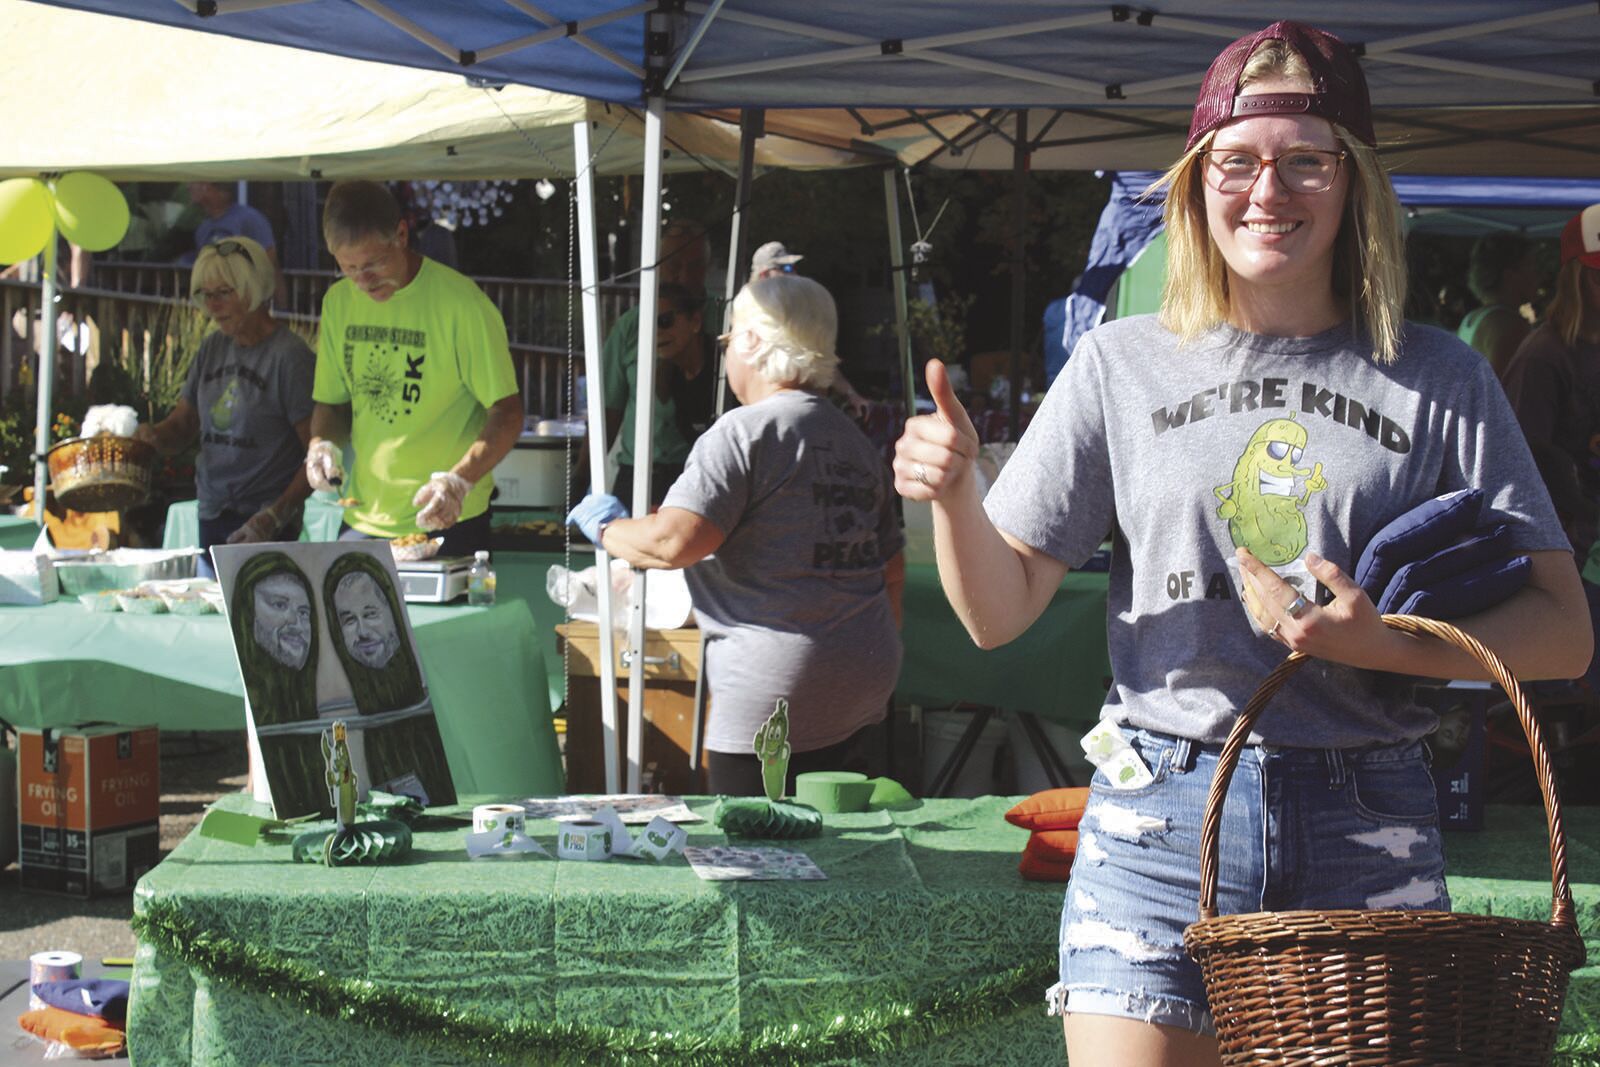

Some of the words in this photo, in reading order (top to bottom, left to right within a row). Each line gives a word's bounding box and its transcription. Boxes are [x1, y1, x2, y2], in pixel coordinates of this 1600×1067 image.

[402, 351, 426, 405] 5K
[1150, 377, 1289, 436] WE'RE
[1300, 381, 1412, 455] KIND
[1166, 570, 1196, 601] OF
[1205, 572, 1232, 600] A
[27, 783, 78, 802] FRYING
[101, 772, 150, 793] FRYING
[41, 802, 64, 817] OIL
[115, 792, 137, 807] OIL
